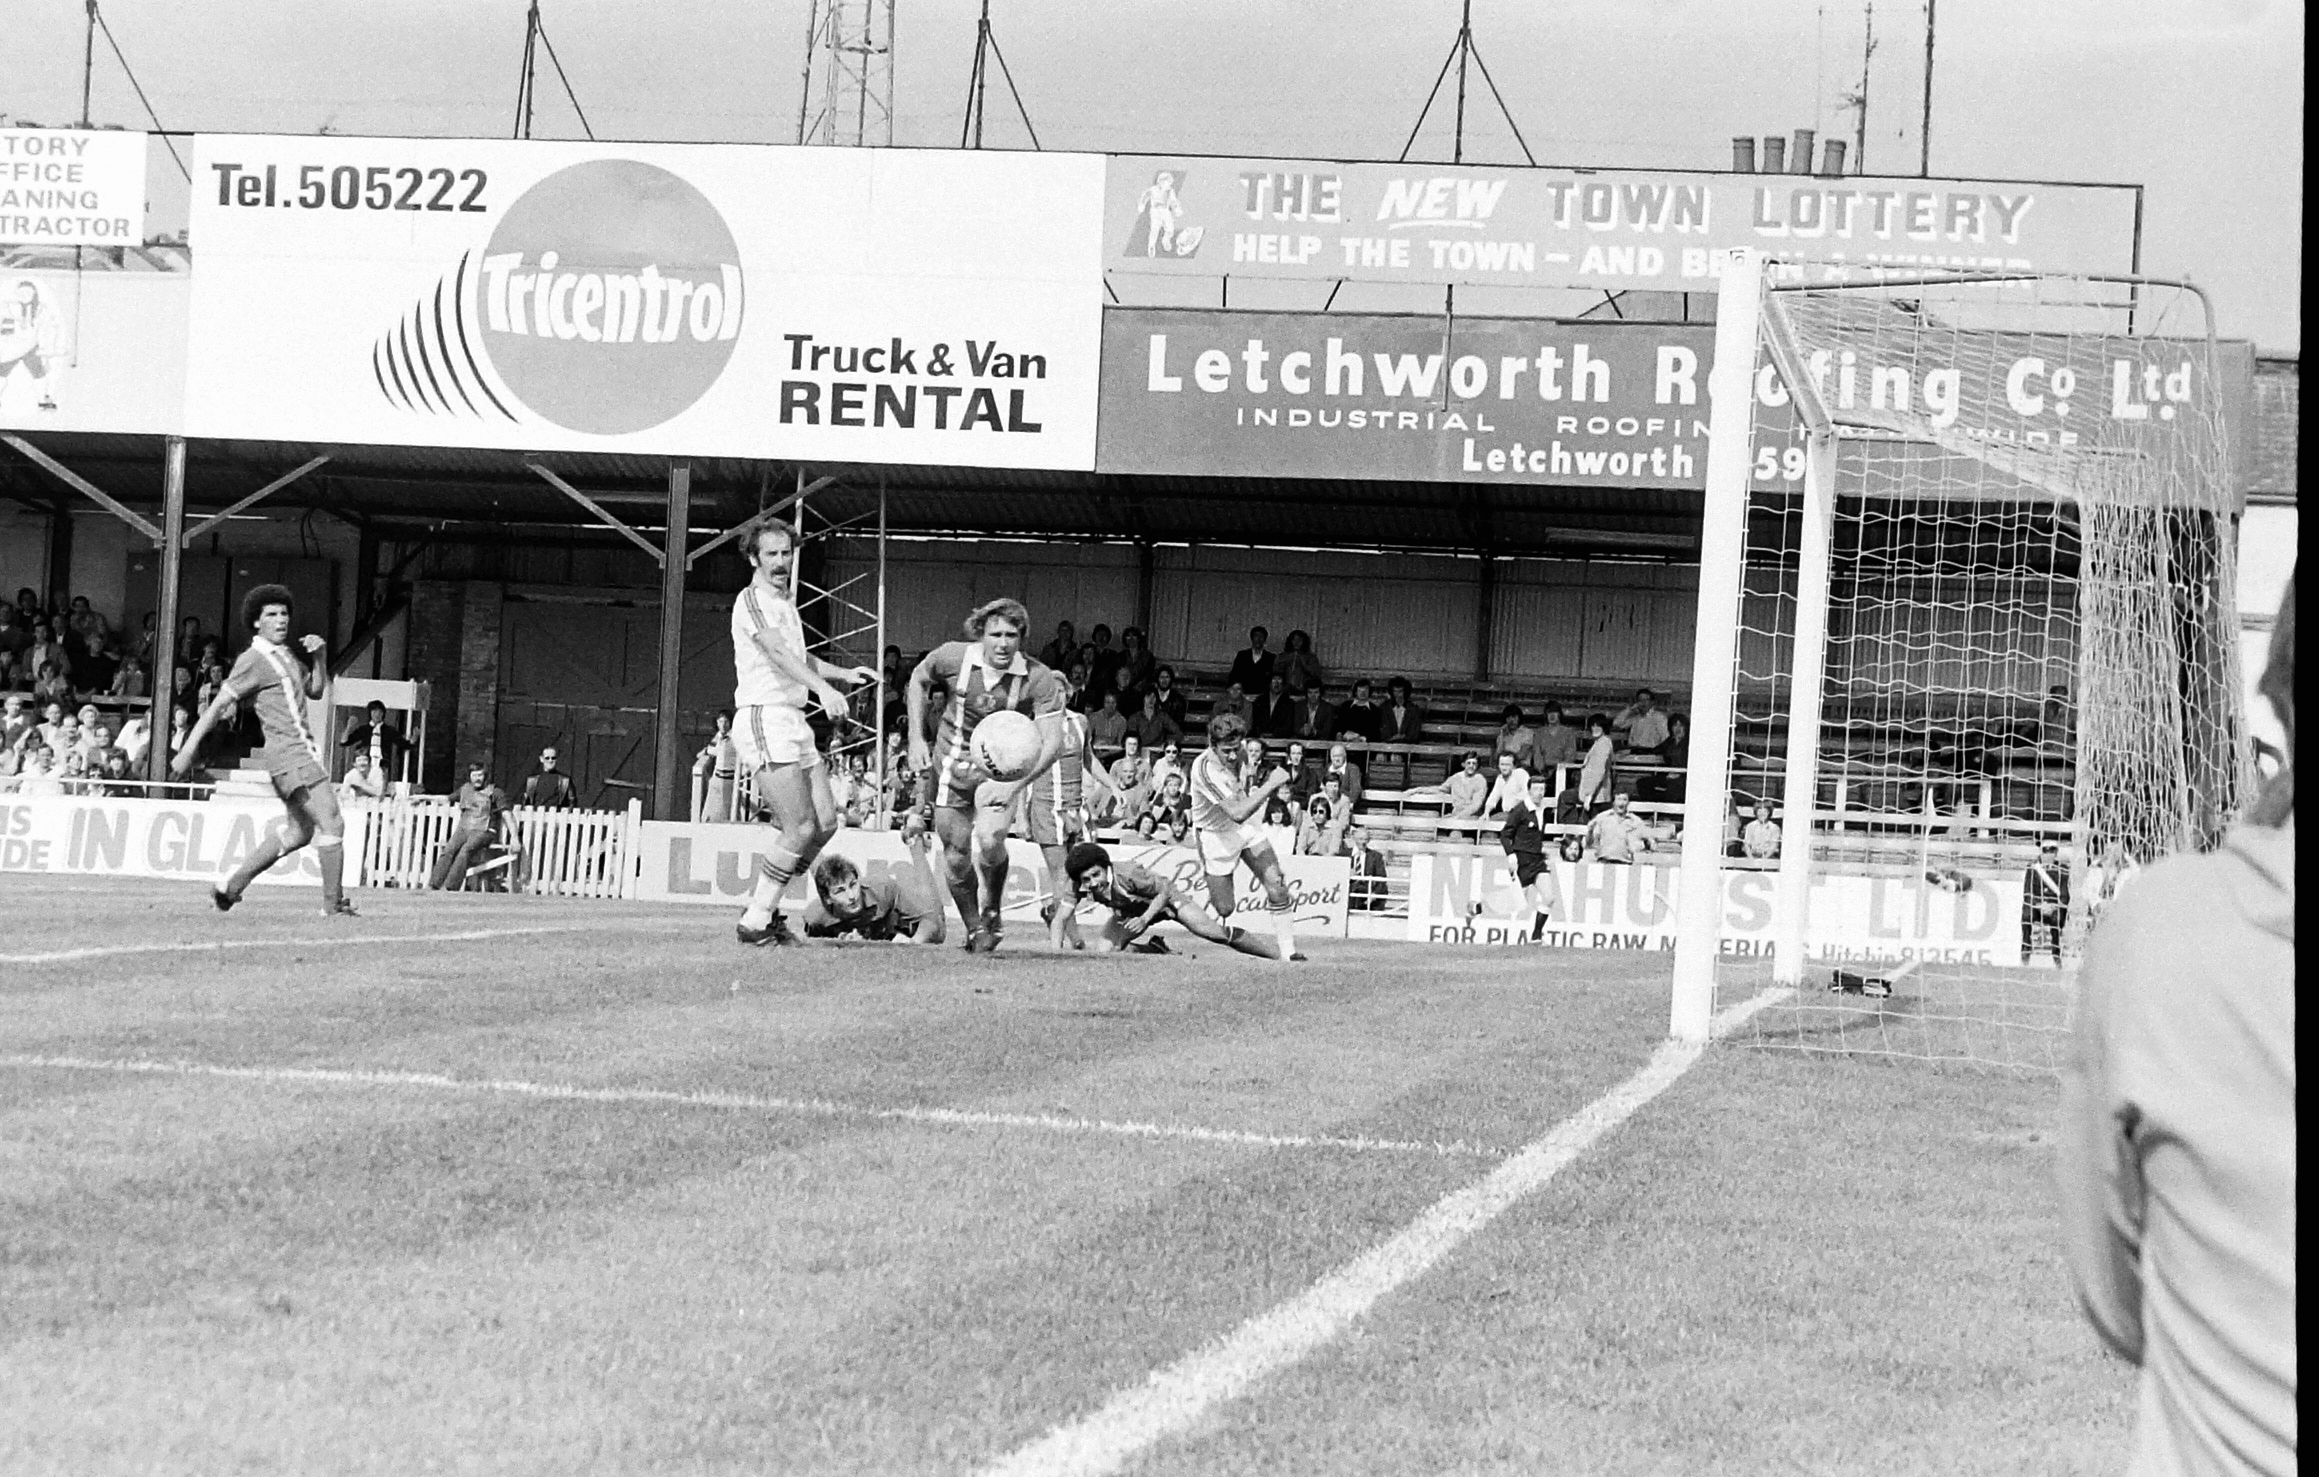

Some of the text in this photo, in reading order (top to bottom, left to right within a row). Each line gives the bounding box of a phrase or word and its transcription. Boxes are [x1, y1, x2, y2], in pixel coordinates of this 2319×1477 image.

[3, 136, 90, 156] TORY
[0, 189, 99, 210] ANING
[1239, 172, 2034, 245] THE NEW TOWN LOTTERY
[1233, 233, 1322, 265] HELP
[1339, 237, 1411, 268] THE
[1428, 239, 1535, 272] TOWN
[1579, 245, 1664, 275] AND
[482, 250, 743, 342] Tricentrol
[783, 333, 1047, 379] Truck & Van
[1147, 334, 1611, 403] Letchworth
[1655, 346, 1960, 428] Rofing
[778, 380, 1043, 433] RENTAL
[1236, 408, 1711, 439] INDUSTRIAL ROOFIN
[1462, 437, 1694, 478] Letchworth
[0, 838, 52, 870] DE
[66, 807, 322, 877] IN GLAS
[1429, 856, 1999, 941] NEAHUS LTD
[1429, 925, 1476, 944] FOR
[1487, 928, 1584, 948] PLATIC
